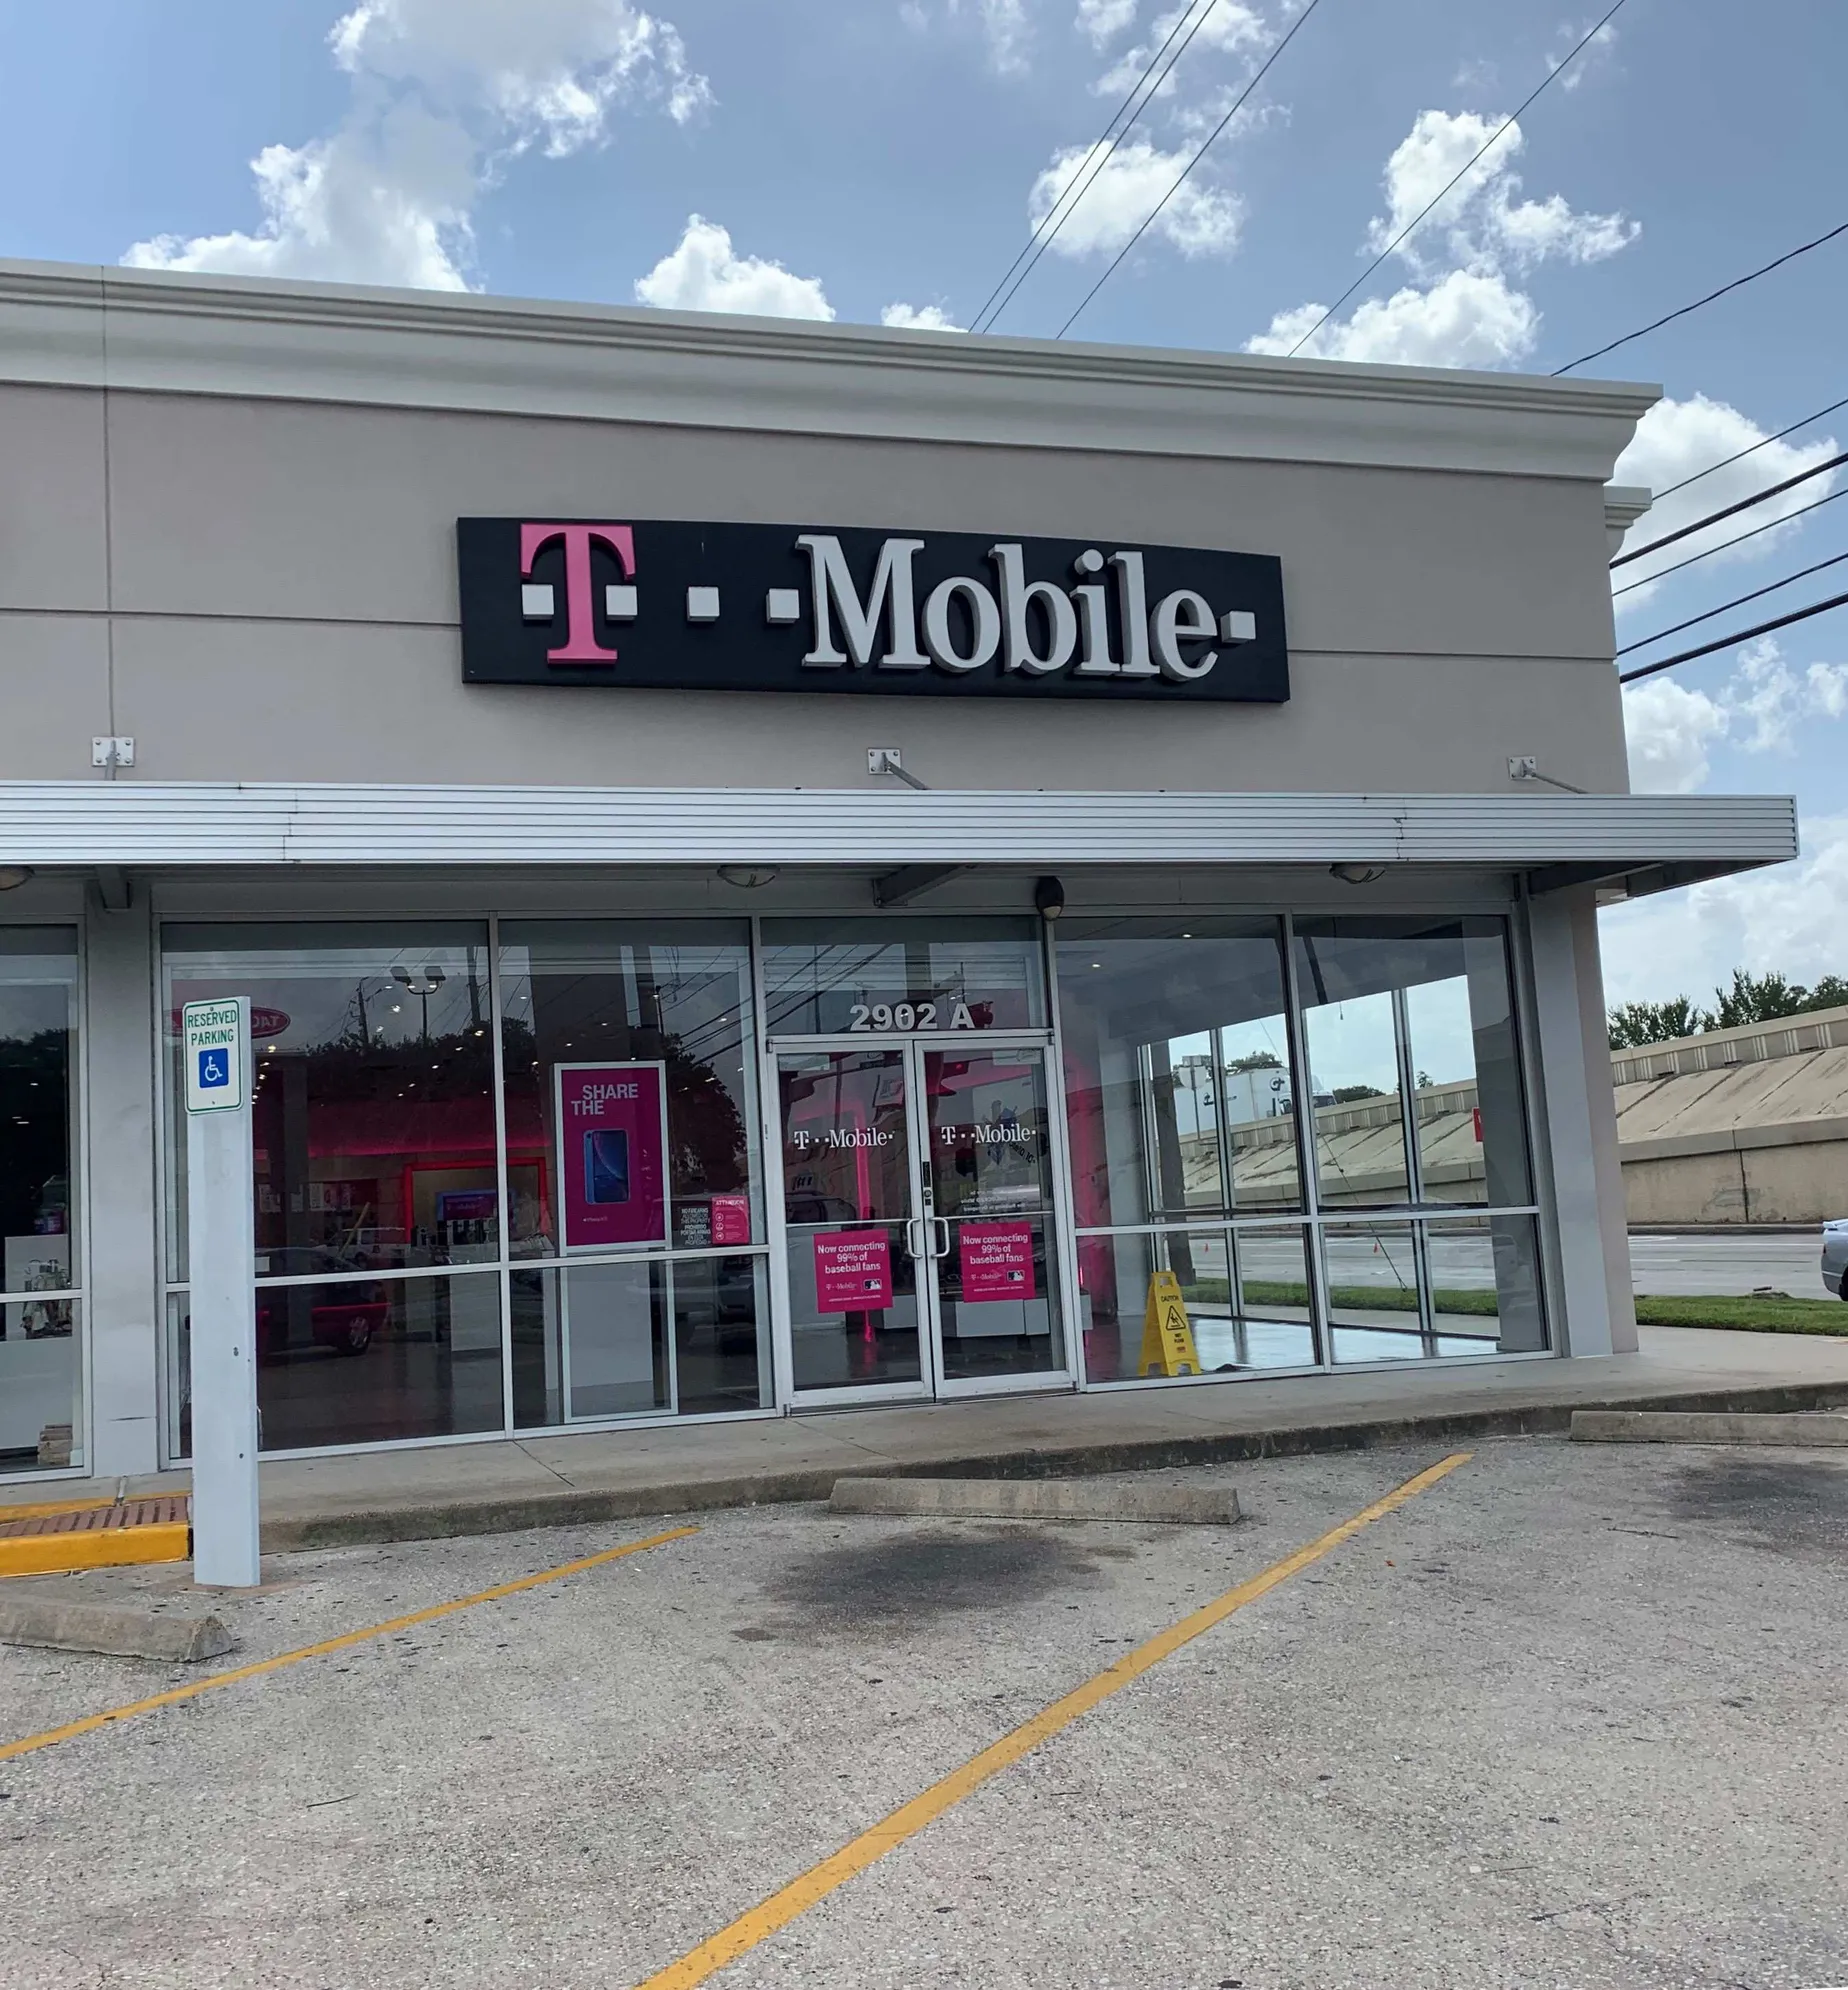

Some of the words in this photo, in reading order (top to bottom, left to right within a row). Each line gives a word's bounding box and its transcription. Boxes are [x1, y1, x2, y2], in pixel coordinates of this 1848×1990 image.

[187, 1010, 237, 1028] RESERVED
[849, 1003, 939, 1031] 2902
[951, 1002, 976, 1029] A
[191, 1029, 234, 1046] PARKING
[582, 1083, 639, 1100] SHARE
[571, 1100, 605, 1116] THE
[962, 1236, 981, 1245] Now
[982, 1232, 1029, 1244] connecting
[817, 1244, 837, 1254] Now
[838, 1241, 886, 1253] connecting
[981, 1244, 1002, 1254] 99%
[1002, 1243, 1011, 1253] of
[836, 1252, 858, 1263] 99%
[859, 1252, 868, 1261] of
[969, 1253, 1005, 1265] baseball
[1005, 1253, 1024, 1263] fans
[824, 1262, 861, 1274] baseball
[862, 1262, 881, 1272] fans
